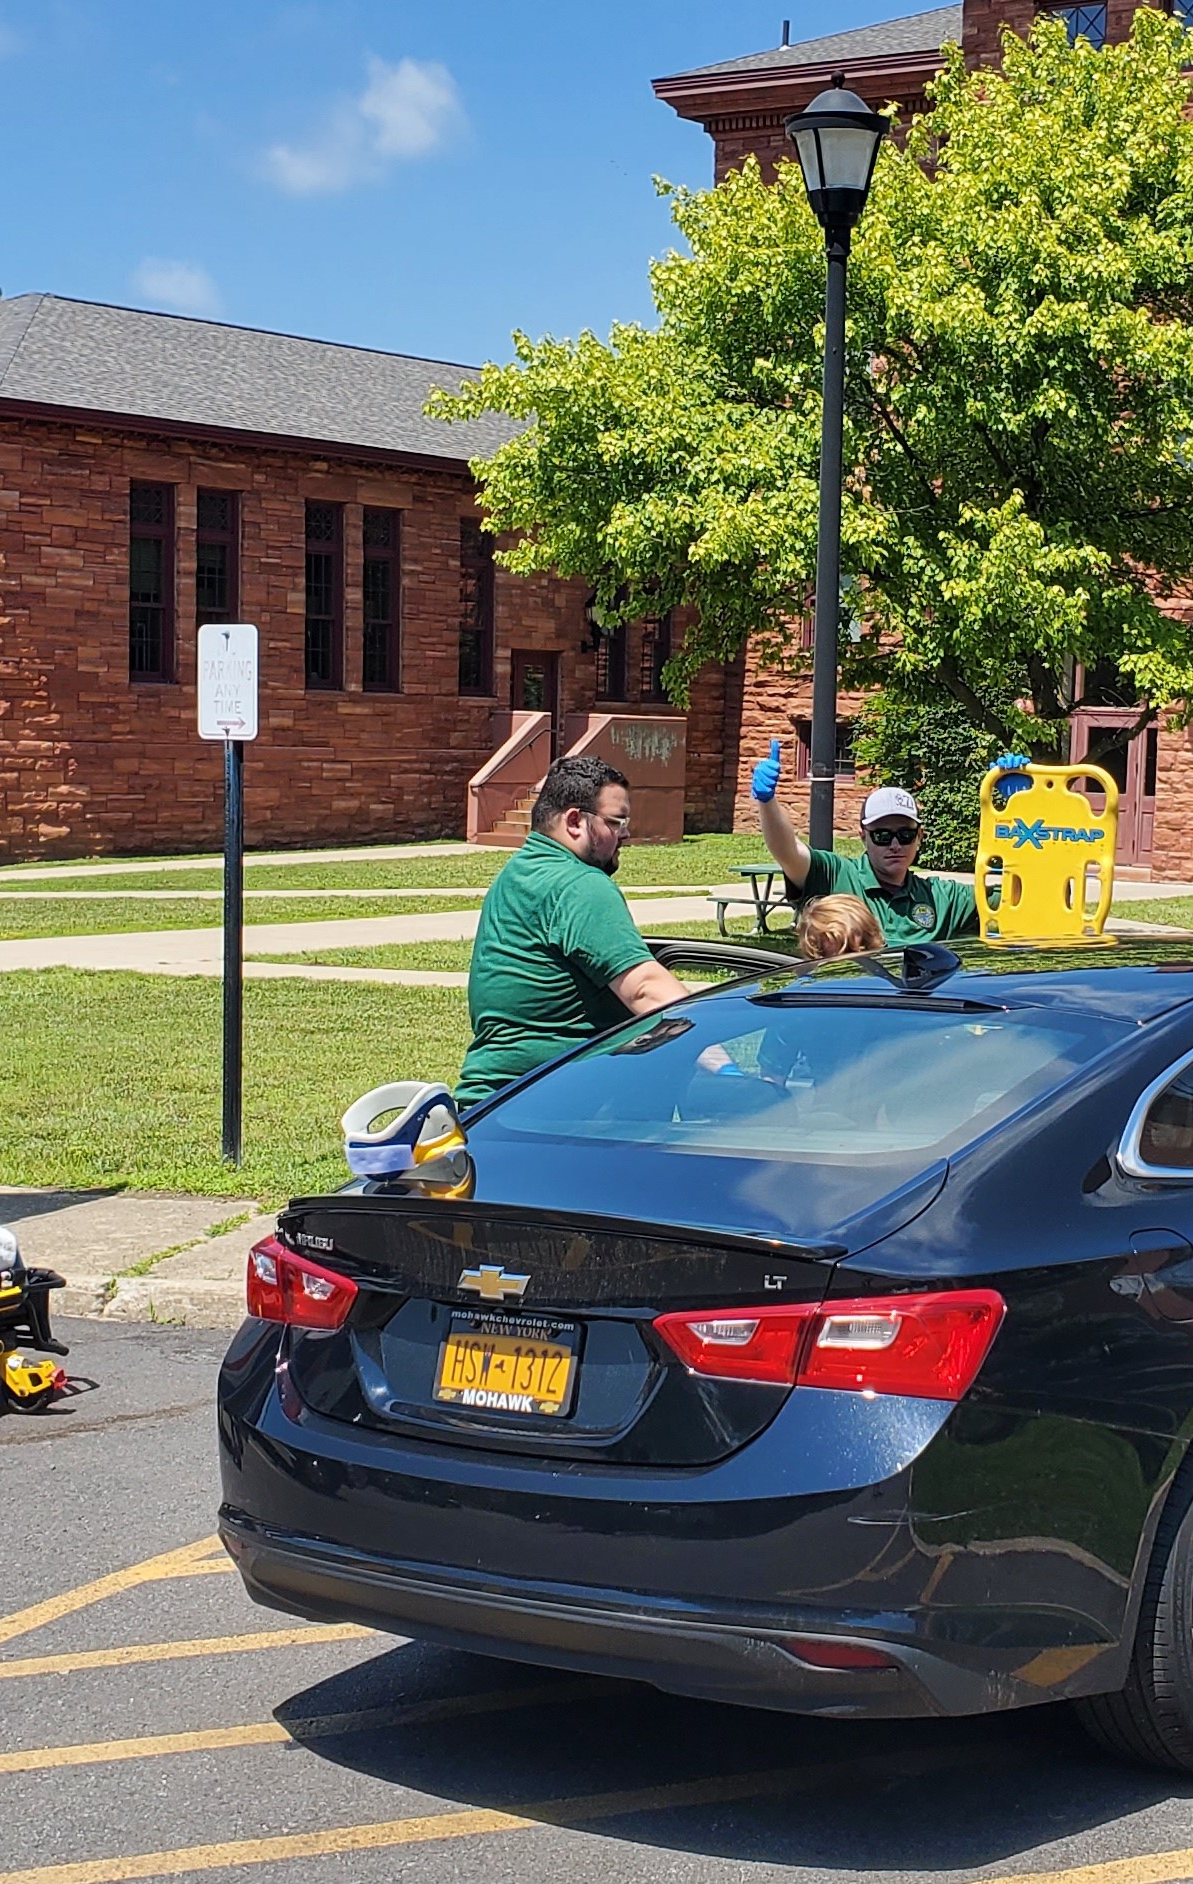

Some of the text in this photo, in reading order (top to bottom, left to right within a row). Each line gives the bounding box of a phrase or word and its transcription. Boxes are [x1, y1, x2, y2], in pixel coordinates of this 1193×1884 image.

[203, 660, 252, 681] PARKING
[214, 683, 240, 698] ANY
[213, 700, 242, 714] TIME
[764, 1274, 788, 1290] LT
[450, 1310, 575, 1331] mohawkchevrolet.com
[480, 1322, 550, 1341] NEW YORK
[462, 1388, 534, 1413] MOHAWK
